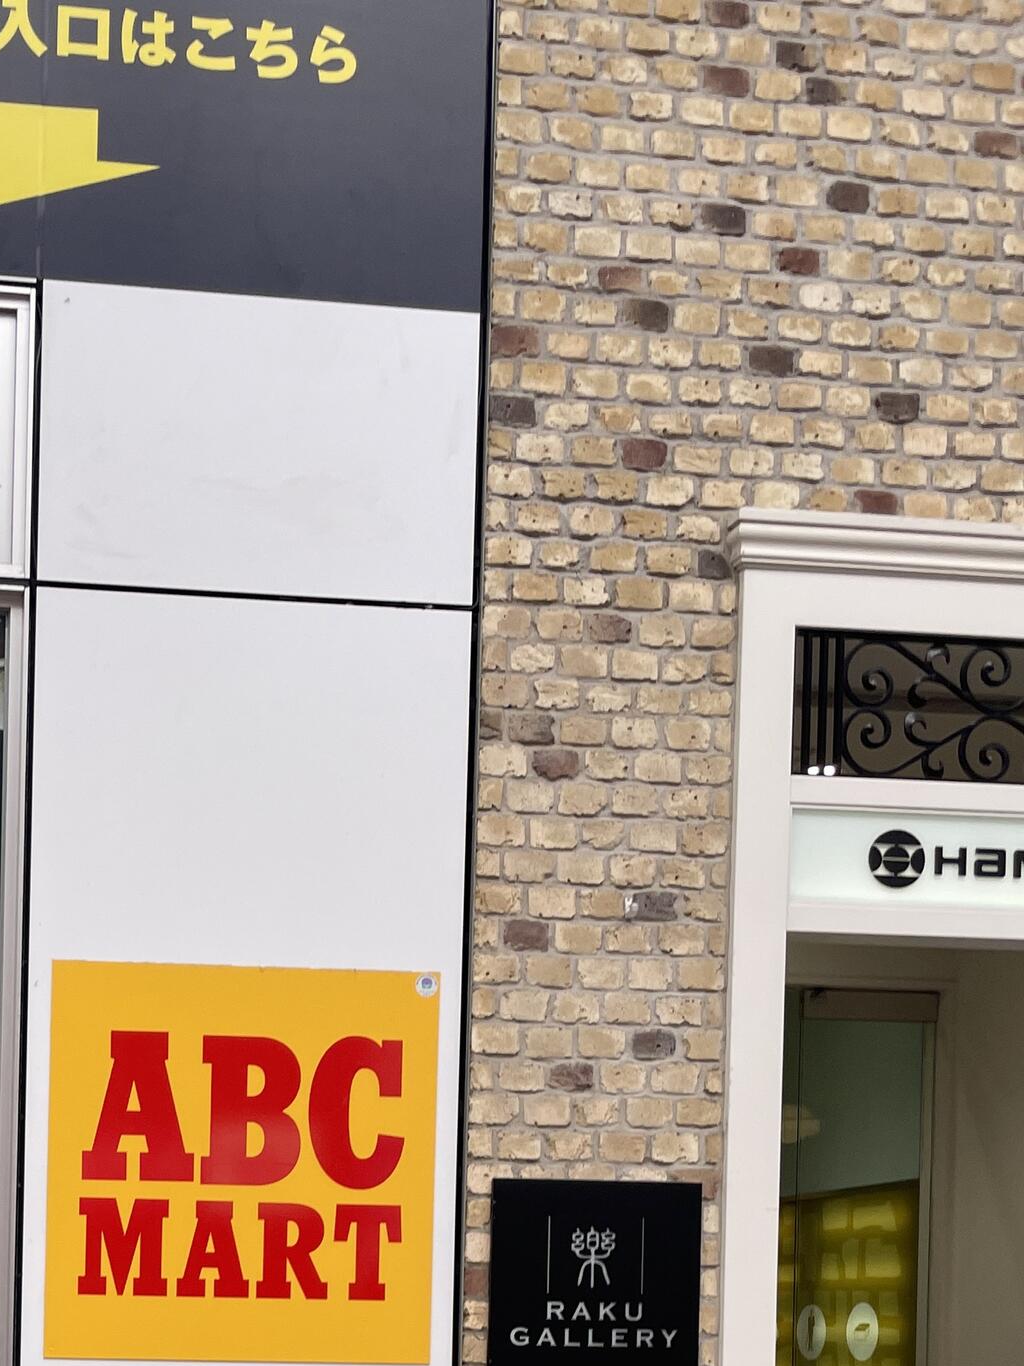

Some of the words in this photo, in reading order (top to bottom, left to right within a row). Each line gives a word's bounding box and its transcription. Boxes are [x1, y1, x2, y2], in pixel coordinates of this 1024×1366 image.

[81, 1030, 405, 1190] ABC
[77, 1197, 403, 1301] MART
[509, 1326, 678, 1348] GALLERY
[545, 1300, 643, 1322] RAKU
